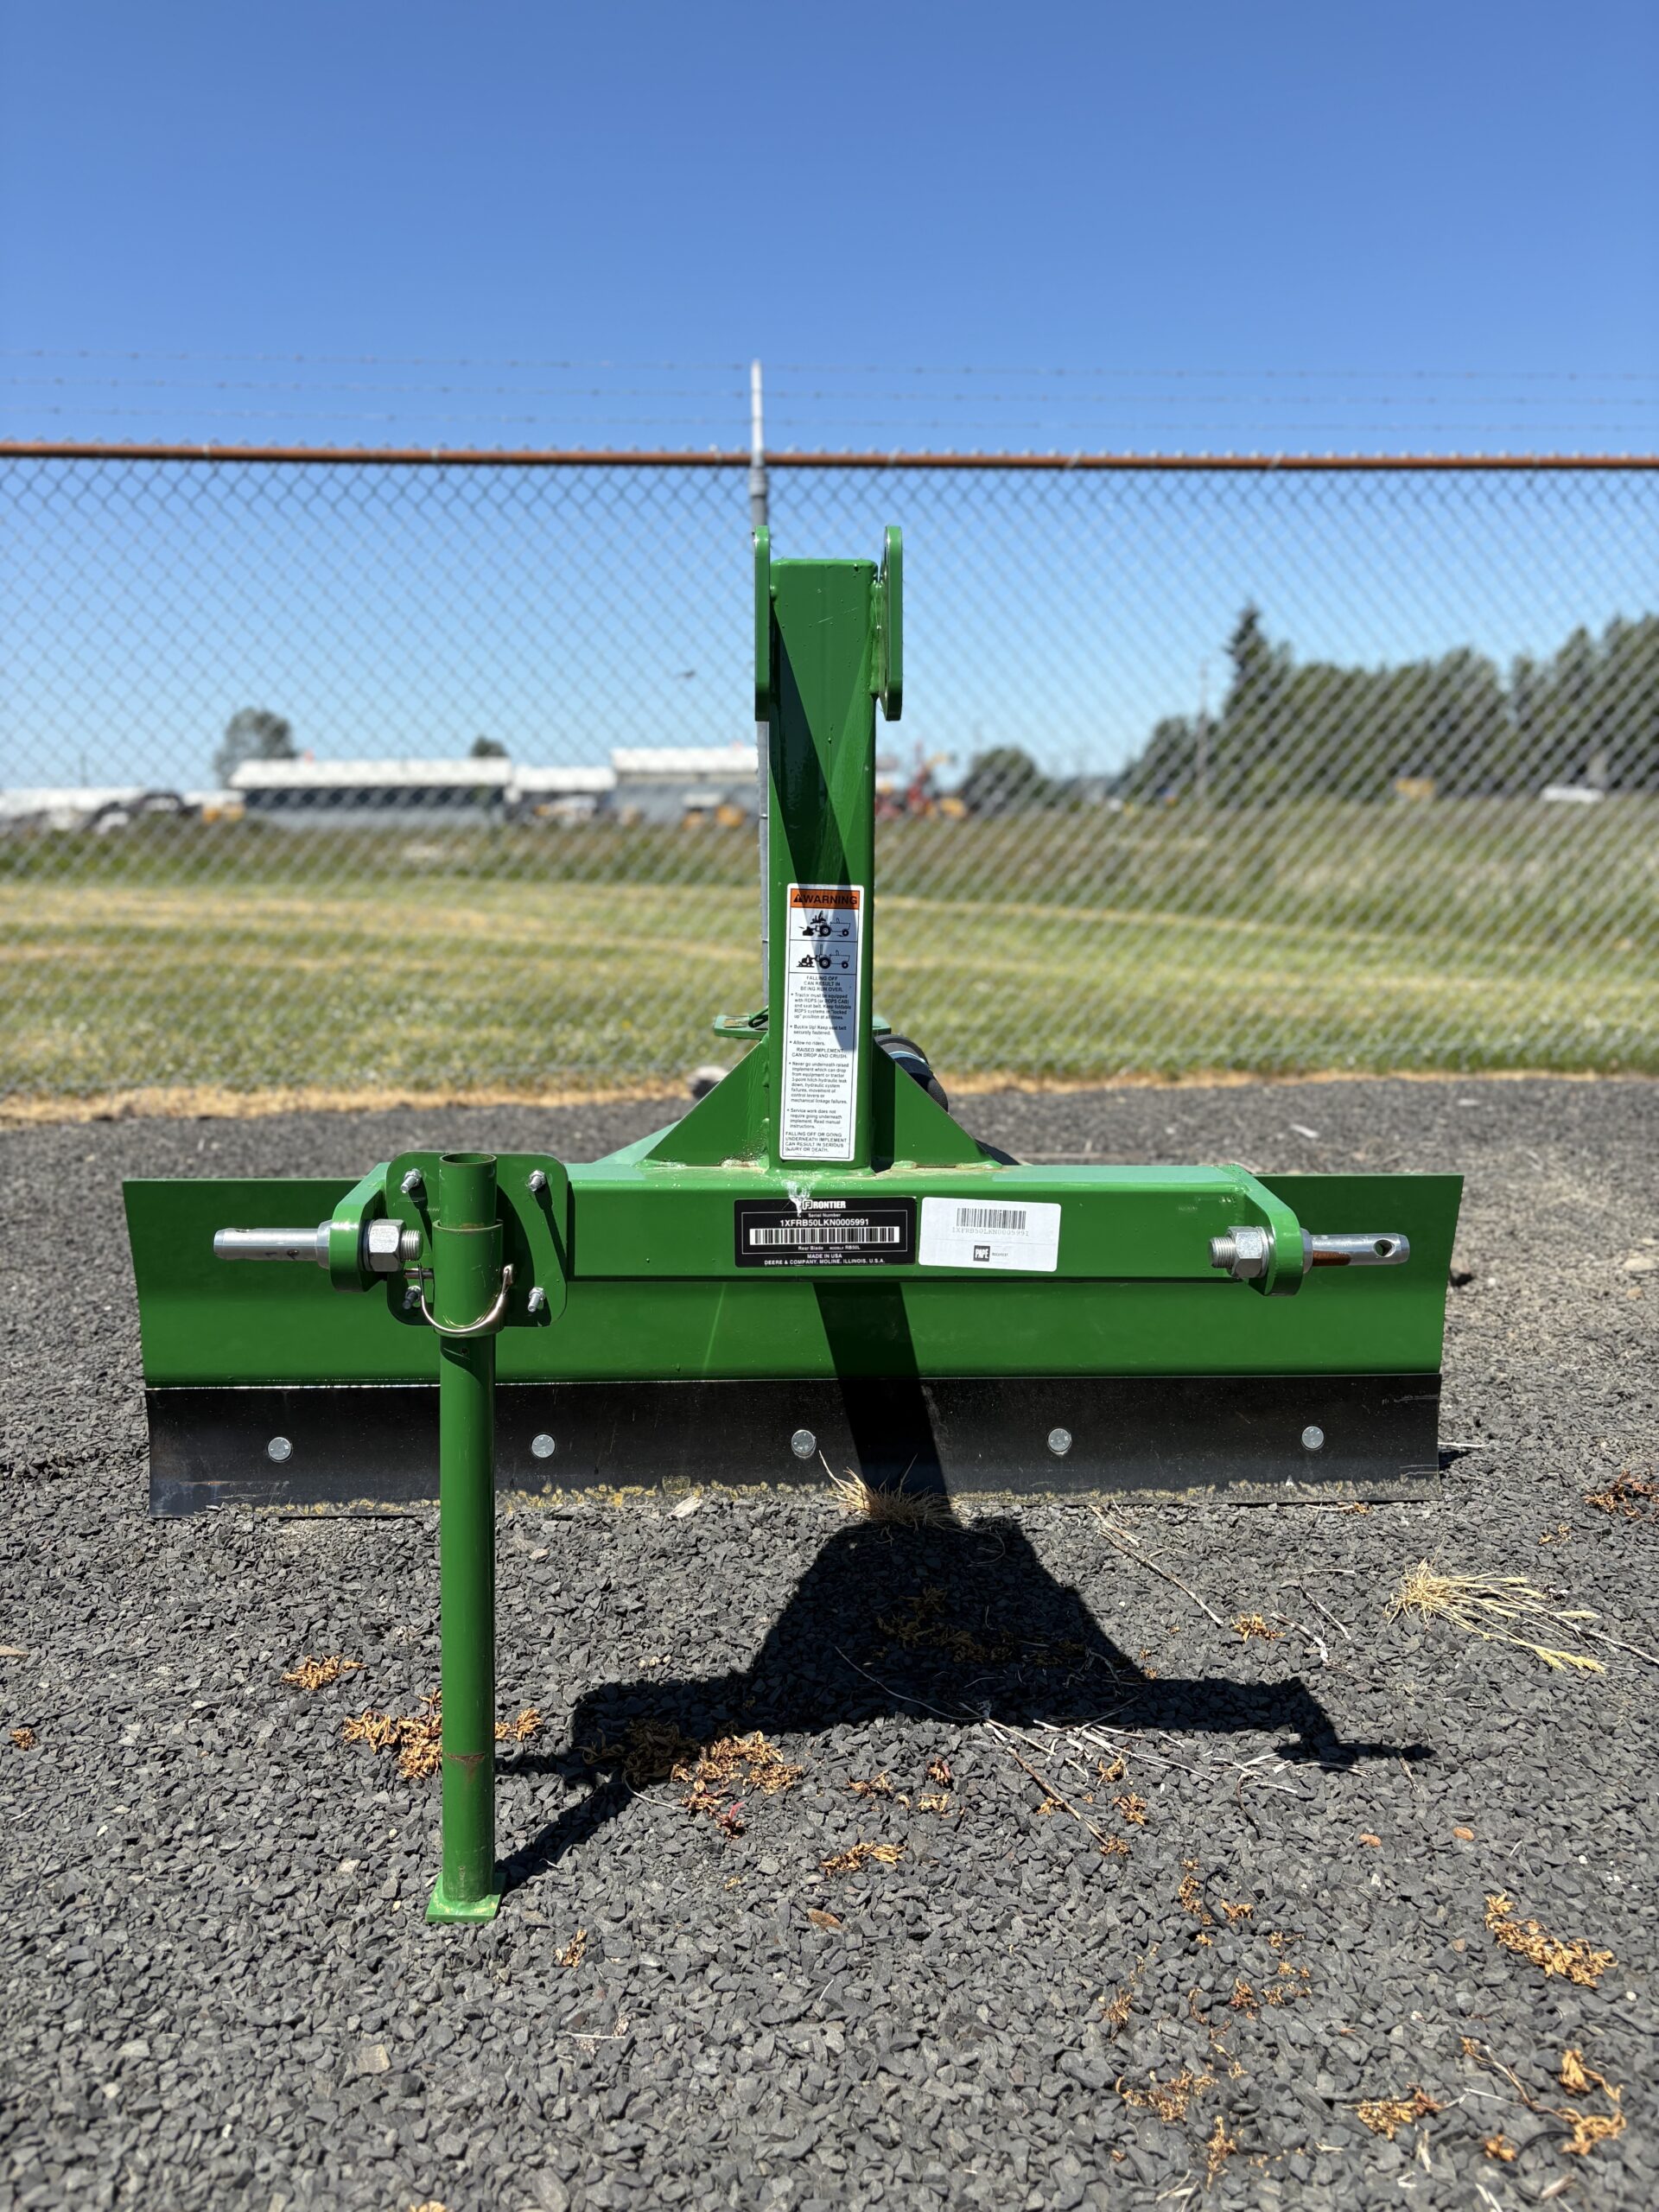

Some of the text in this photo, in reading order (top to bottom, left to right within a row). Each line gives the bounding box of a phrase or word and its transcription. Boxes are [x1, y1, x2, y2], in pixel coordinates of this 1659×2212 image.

[802, 894, 857, 904] WARNING
[802, 1199, 846, 1210] FRONTIER
[780, 1219, 869, 1227] 1XFRB50LKN0005991
[952, 1227, 1029, 1236] 1XFRB50LKN0005991
